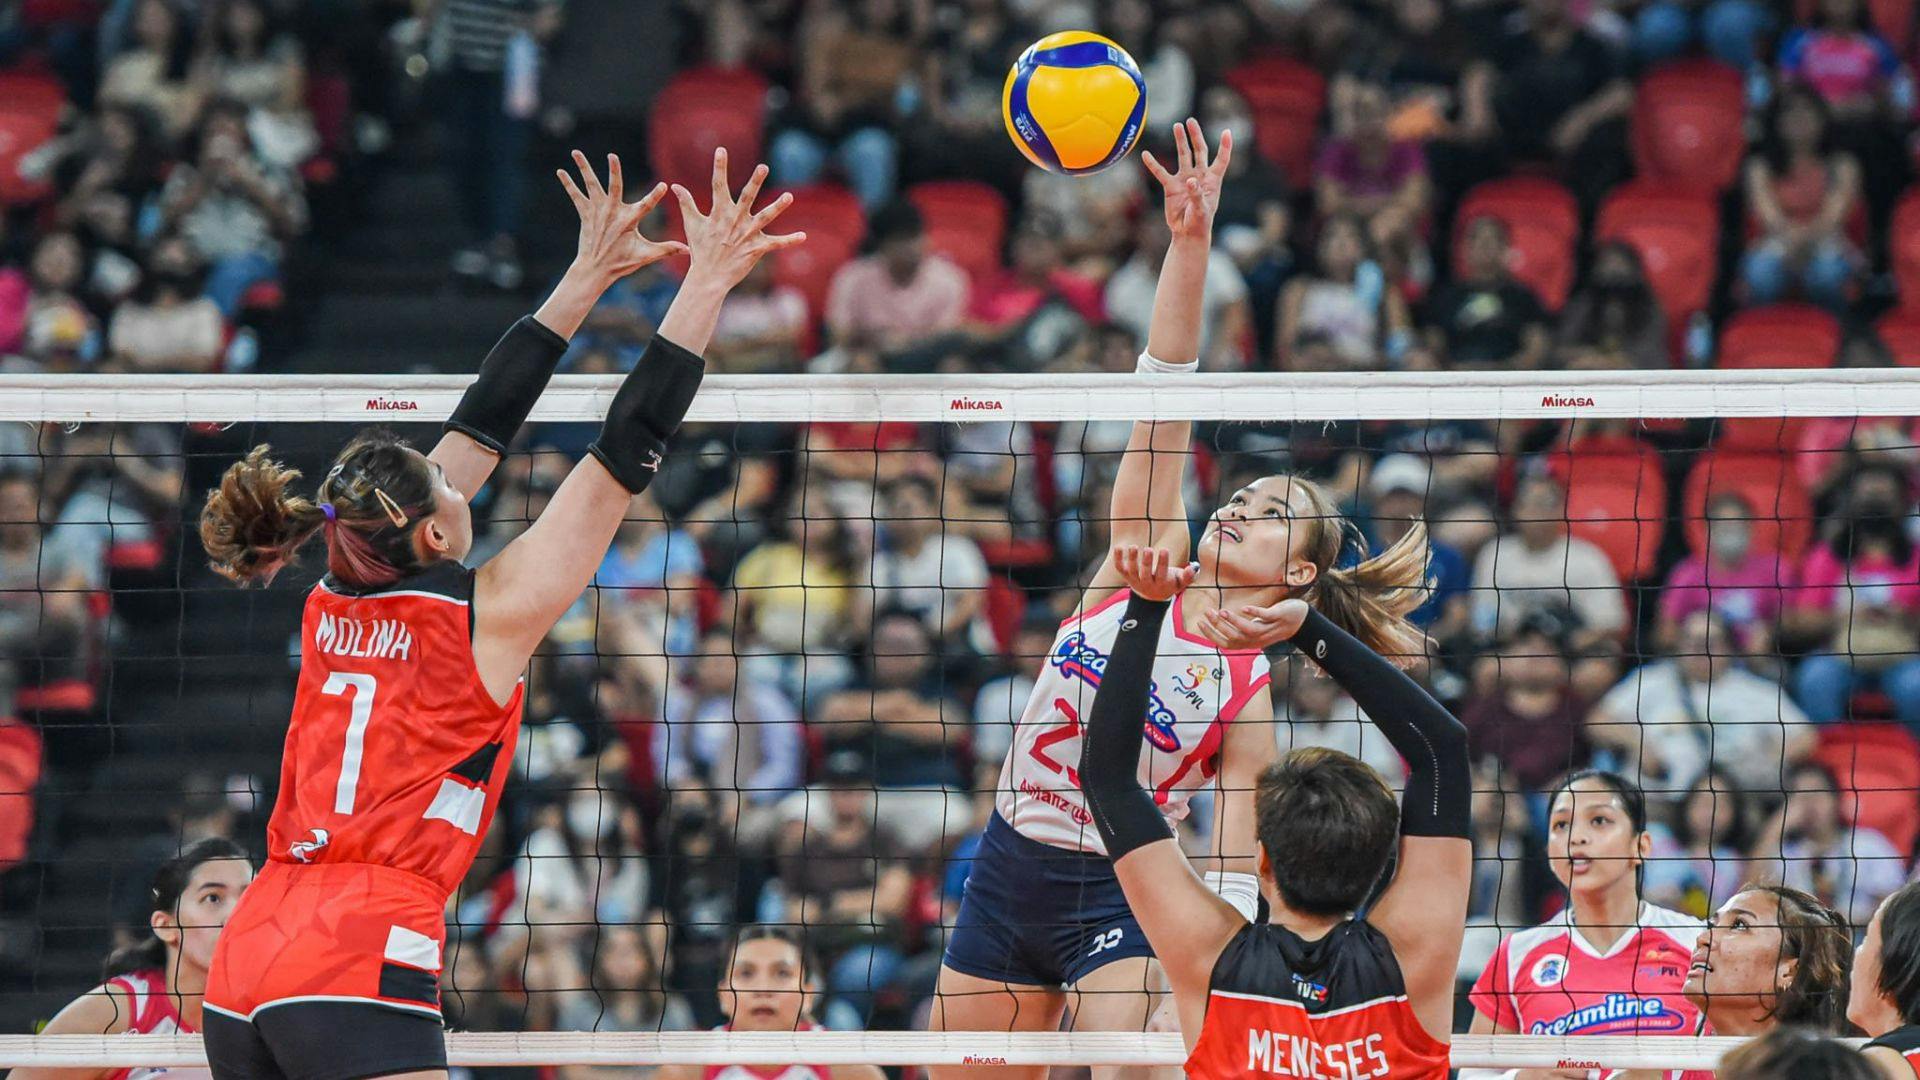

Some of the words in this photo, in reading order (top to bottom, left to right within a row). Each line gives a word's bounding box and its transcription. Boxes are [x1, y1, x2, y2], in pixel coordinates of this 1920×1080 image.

[366, 396, 418, 410] MiKASA
[950, 396, 1003, 410] MiKASA
[1541, 393, 1595, 407] MiKASA
[315, 611, 413, 661] MOLINA
[1052, 632, 1174, 728] Creane
[1185, 691, 1204, 710] PVL
[321, 671, 377, 815] 7
[1661, 966, 1680, 977] PVL
[1248, 1028, 1390, 1080] MENESES
